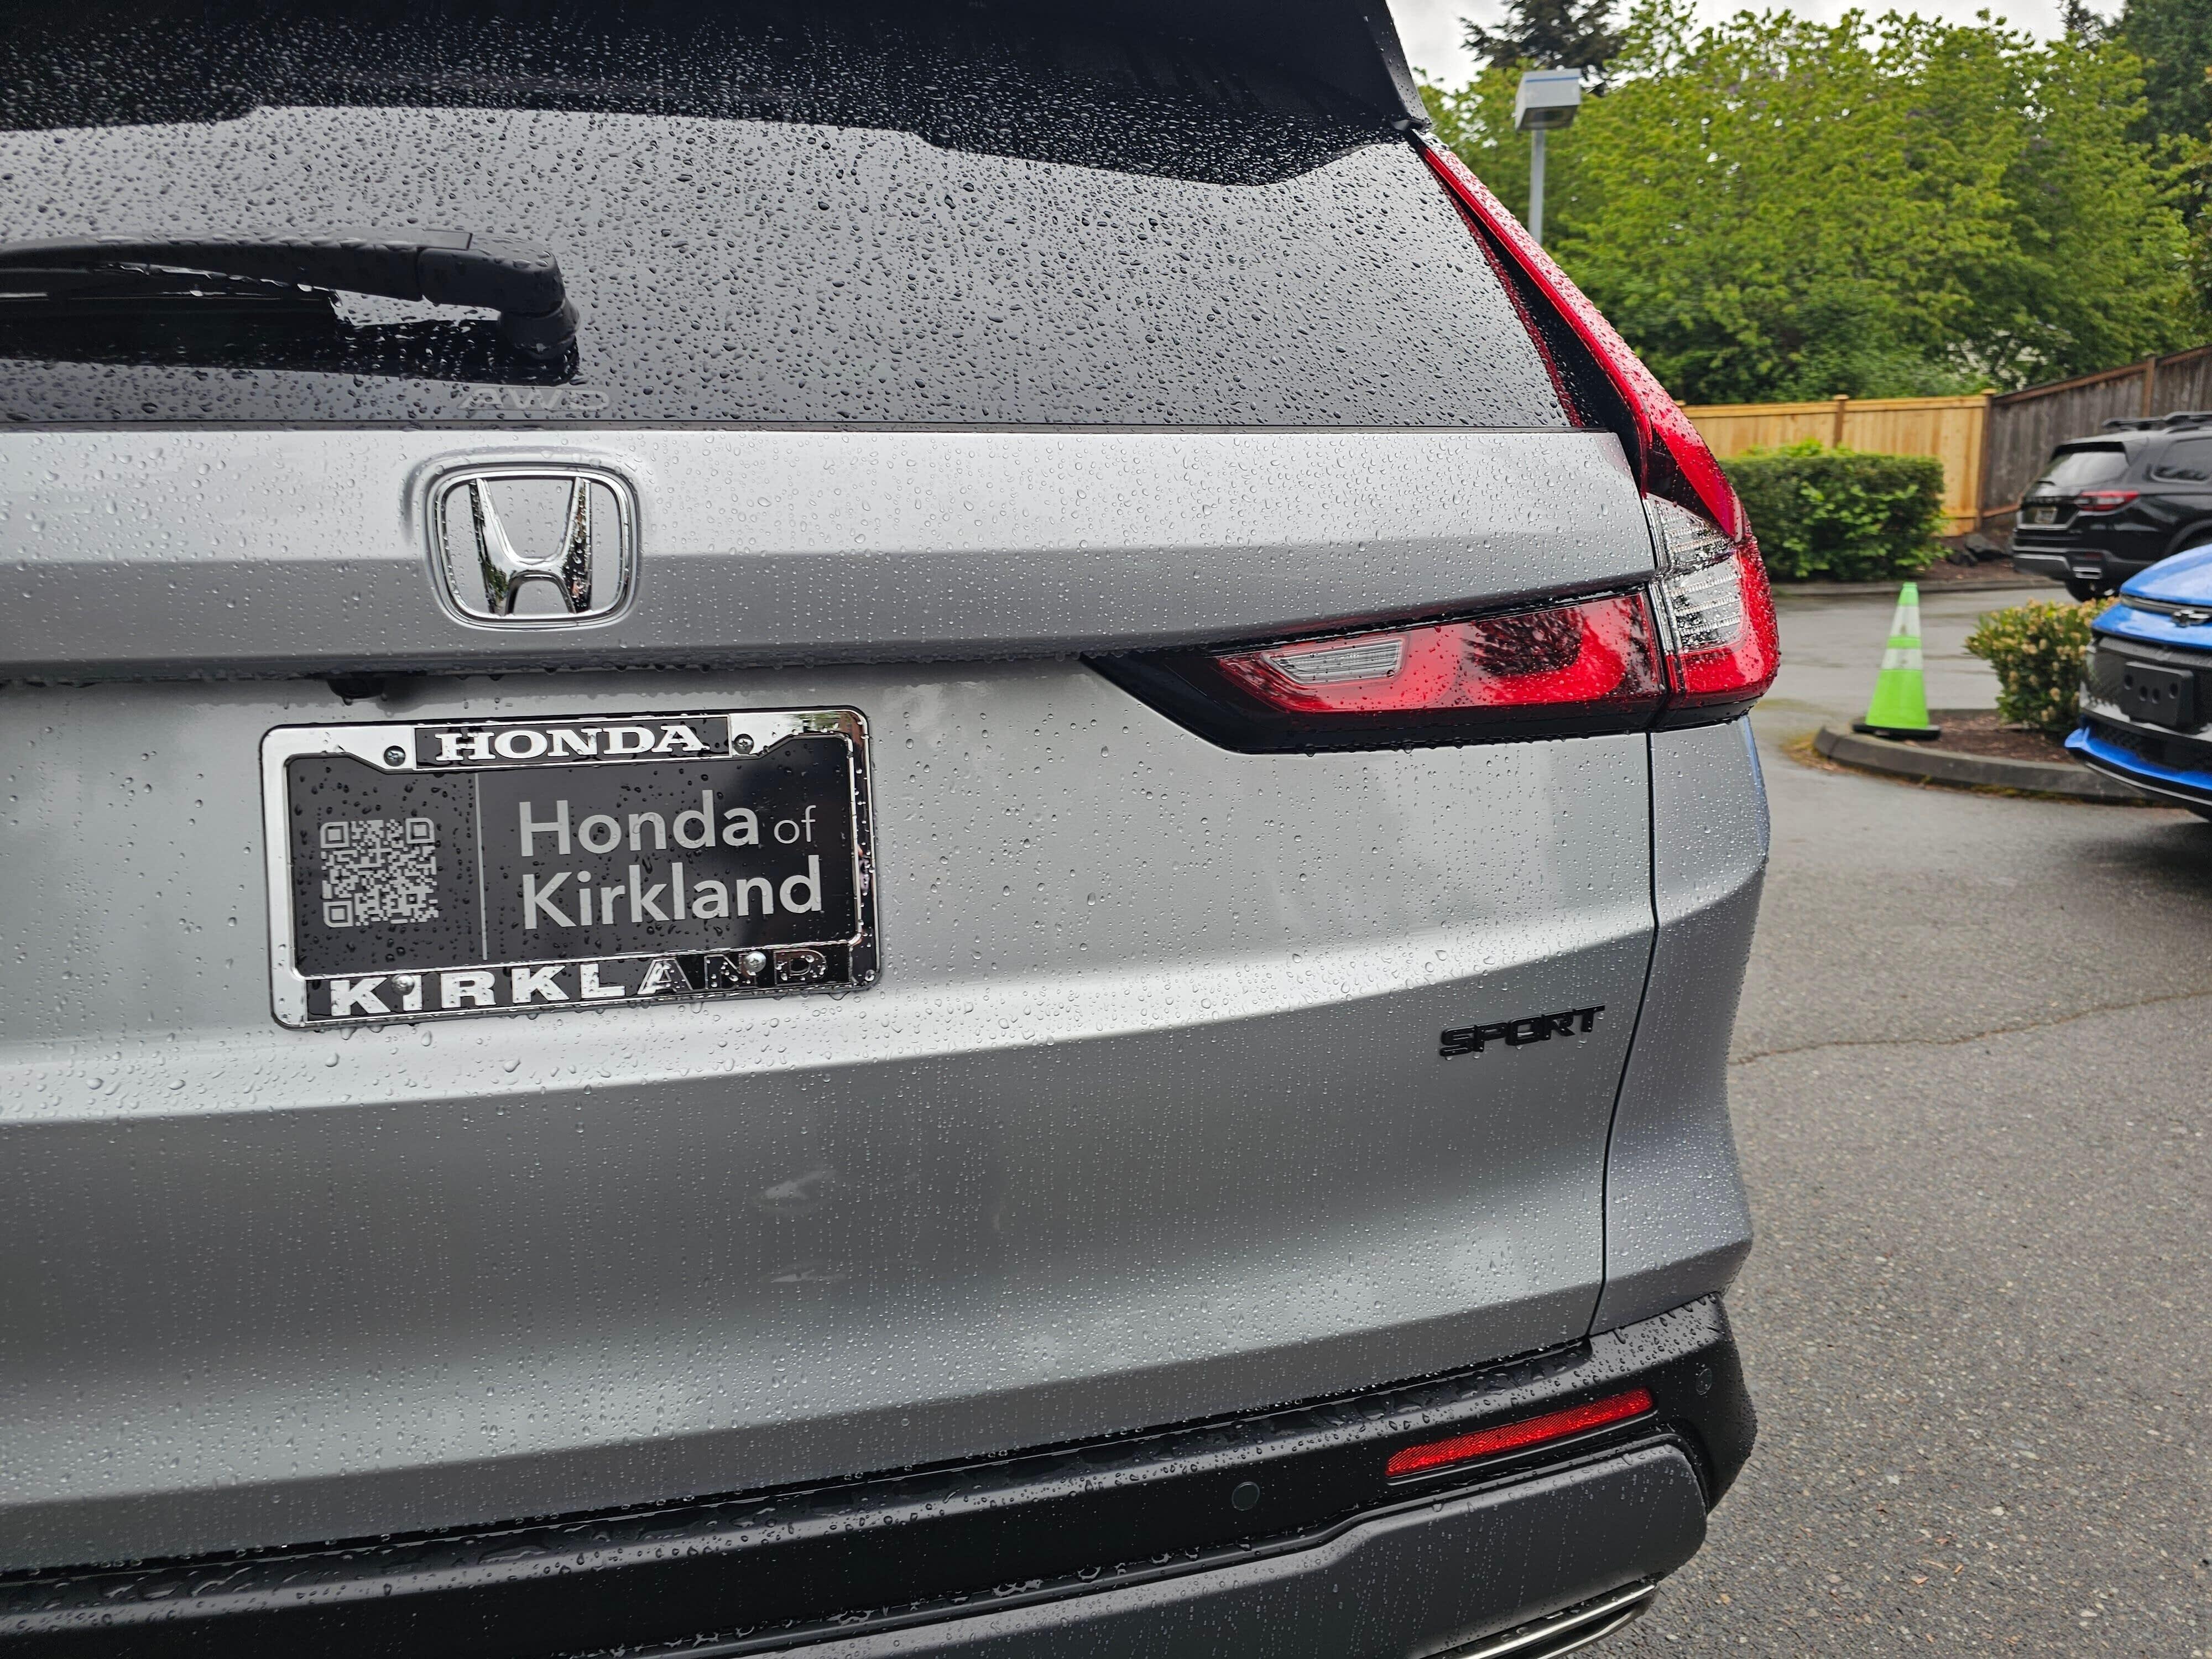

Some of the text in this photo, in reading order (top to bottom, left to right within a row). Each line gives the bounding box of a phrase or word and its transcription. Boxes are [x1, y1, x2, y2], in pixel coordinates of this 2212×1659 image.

[457, 388, 609, 411] AWD
[435, 726, 710, 761] HONDA
[519, 789, 818, 857] Honda of
[523, 855, 822, 930] Kirkland
[331, 948, 828, 1016] KIRKLAND
[1439, 1004, 1605, 1056] SPORT
